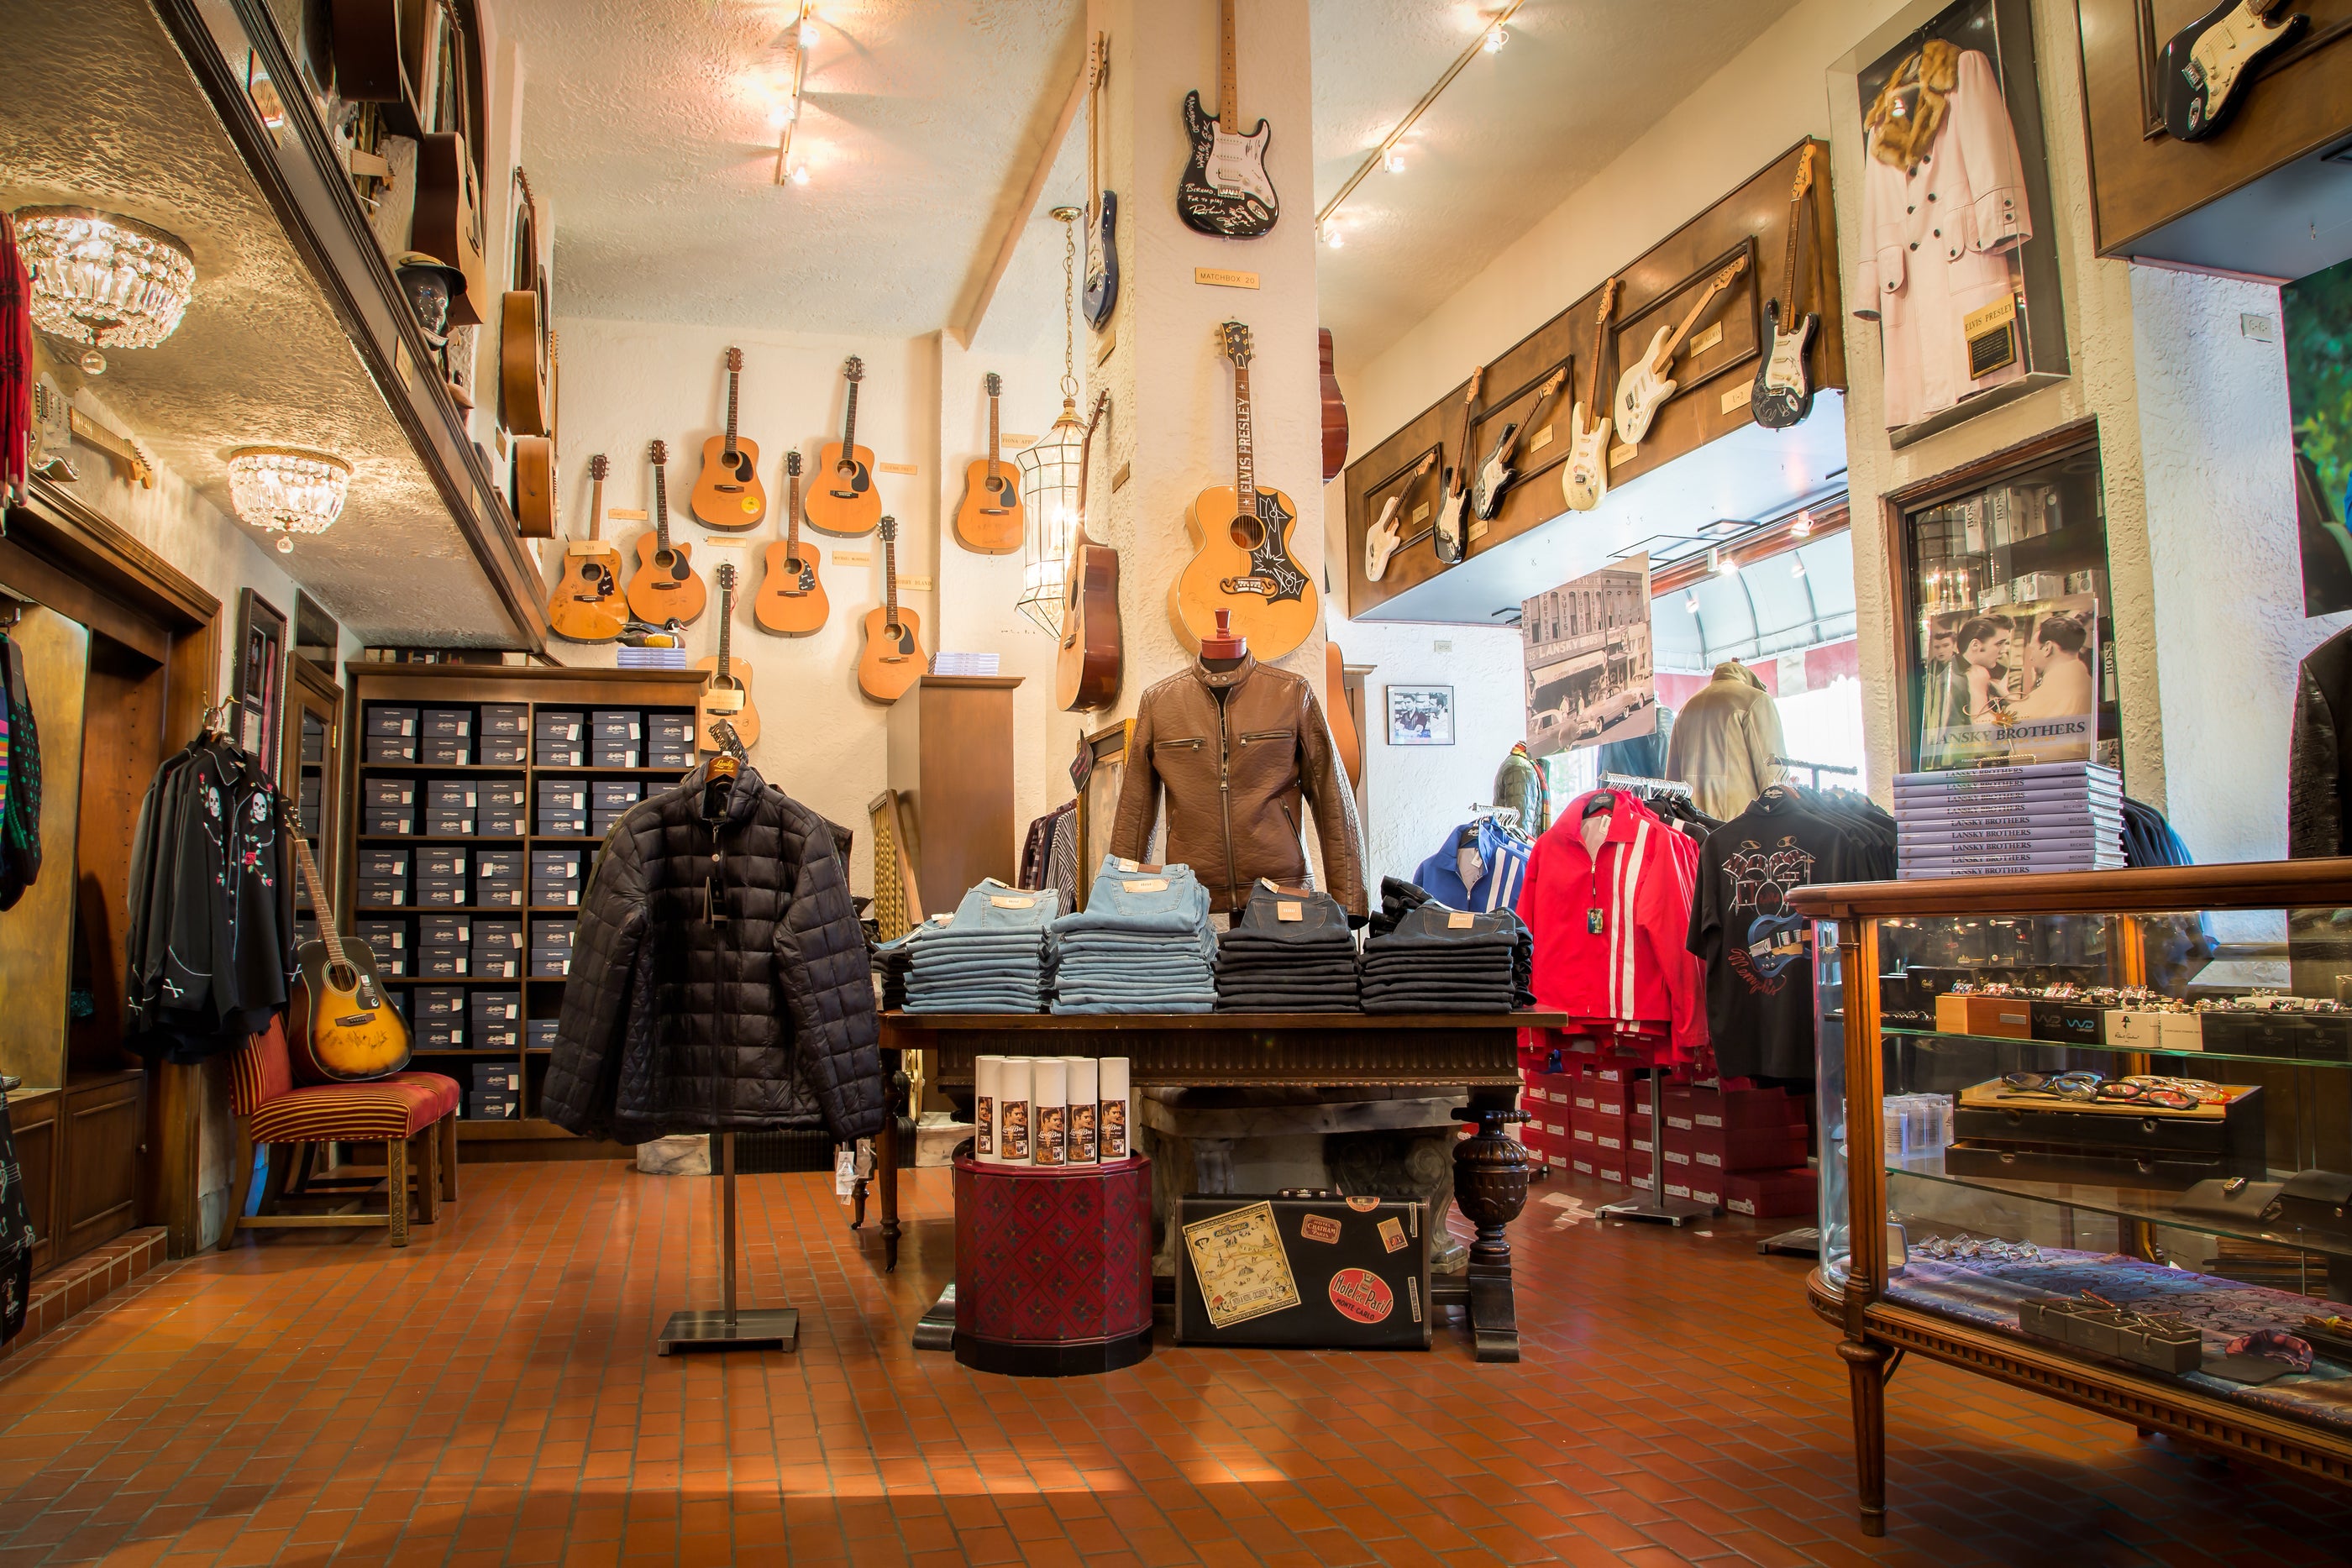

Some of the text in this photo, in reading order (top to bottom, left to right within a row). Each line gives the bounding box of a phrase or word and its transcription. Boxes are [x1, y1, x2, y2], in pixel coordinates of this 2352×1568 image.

[1200, 273, 1241, 283] MATCHBOX
[1966, 303, 2013, 332] ELVIS PRESLEY
[1236, 397, 1252, 493] ELVIS PRESLEY
[1538, 639, 1579, 658] LANSKY
[1996, 721, 2086, 741] BROTHERS
[1979, 768, 2023, 776] BROTHERS
[1980, 779, 2024, 788] BROTHERS
[1981, 792, 2025, 800] BROTHERS
[1981, 805, 2025, 813] BROTHERS
[1985, 816, 2029, 825] BROTHERS
[1986, 829, 2031, 837] BROTHERS
[1952, 843, 1985, 852] LANSKY
[1986, 842, 2031, 850] BROTHERS
[1986, 854, 2031, 863] BROTHERS
[1307, 1222, 1336, 1235] CHATHAM
[1332, 1274, 1359, 1299] Hotel
[1363, 1289, 1393, 1314] Paris
[1335, 1298, 1375, 1321] MONTE CARLO
